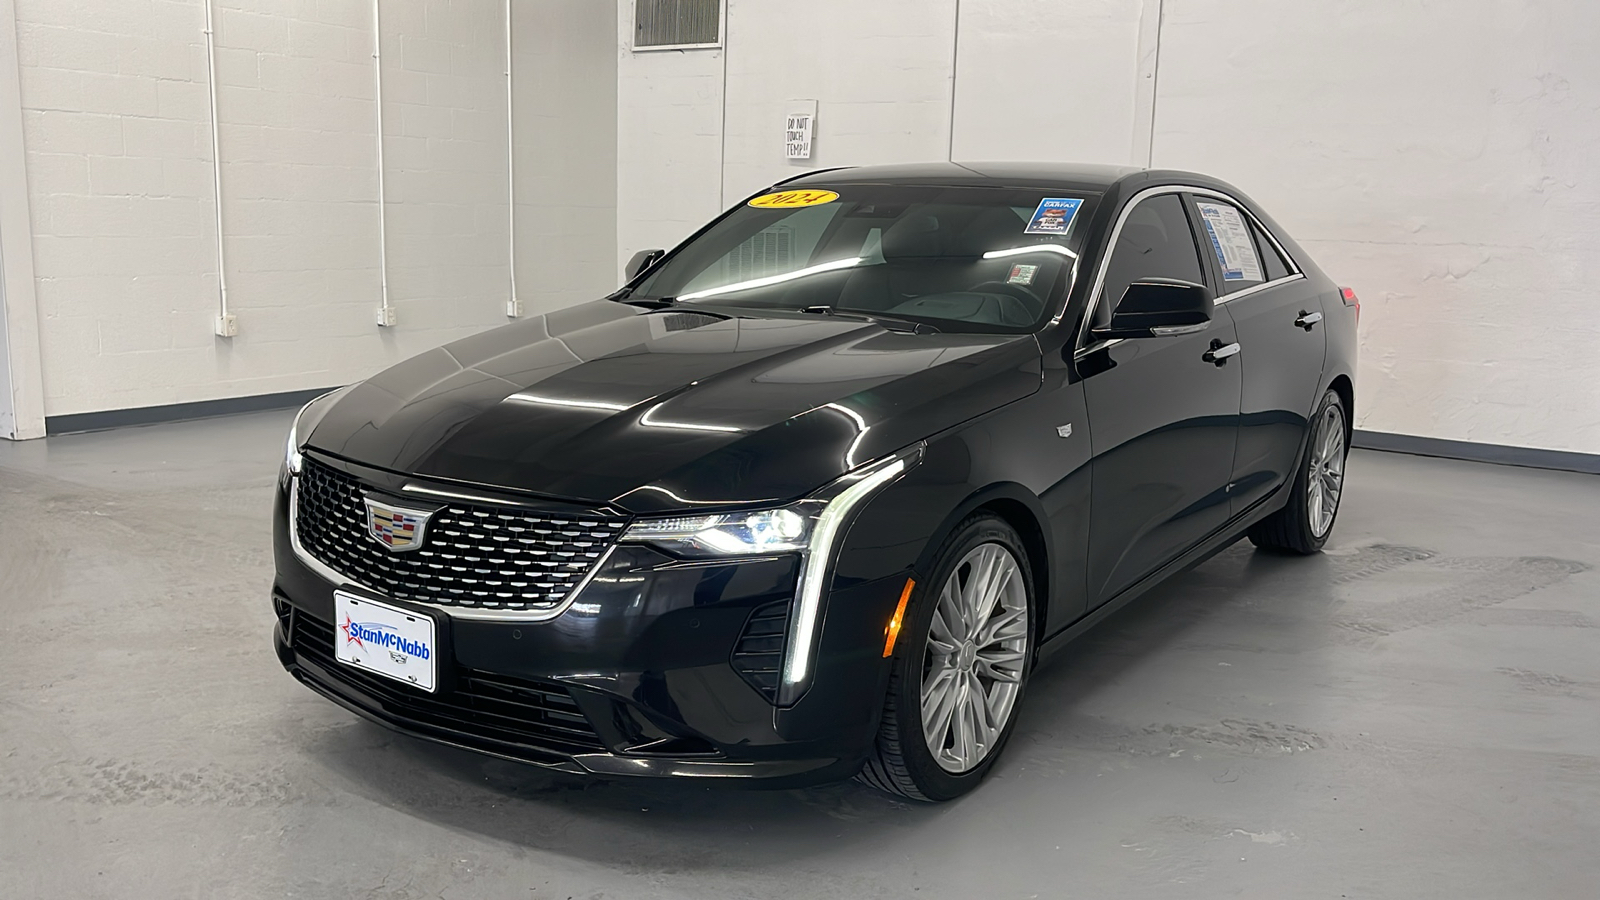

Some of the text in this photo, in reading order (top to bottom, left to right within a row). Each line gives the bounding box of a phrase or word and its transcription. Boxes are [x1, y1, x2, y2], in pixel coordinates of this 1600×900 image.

[787, 117, 809, 130] DO NOT
[786, 130, 804, 142] TOUCH
[757, 193, 830, 205] 2024
[350, 622, 430, 661] StanMcNabb
